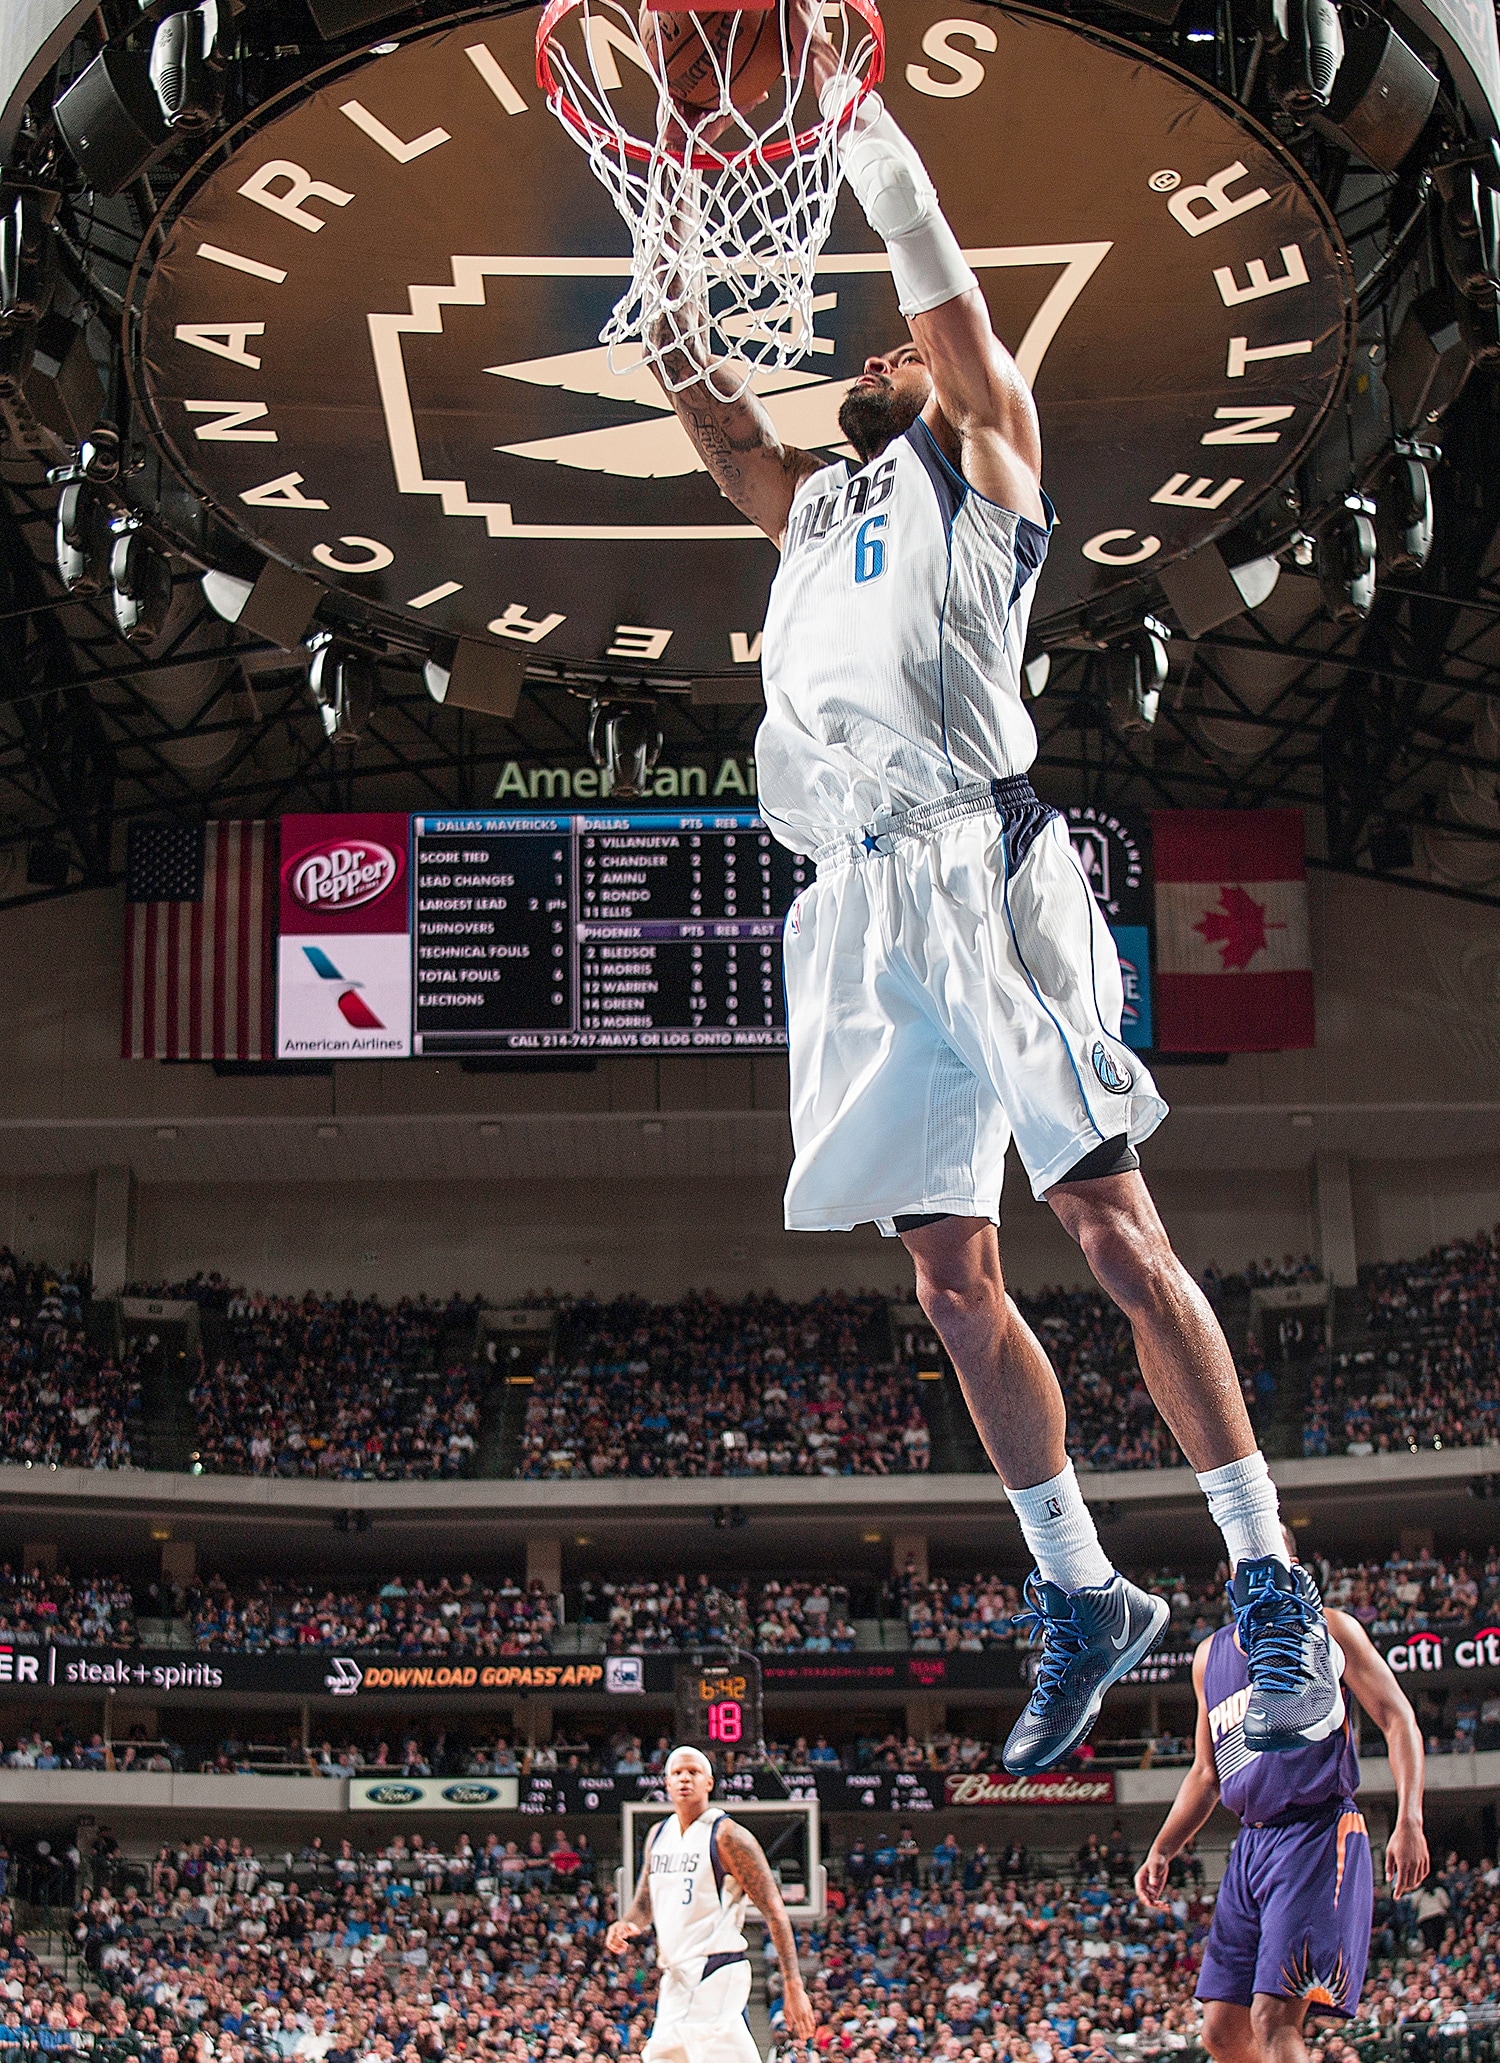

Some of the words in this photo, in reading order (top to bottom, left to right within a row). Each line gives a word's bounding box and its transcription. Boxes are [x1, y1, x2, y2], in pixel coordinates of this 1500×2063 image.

[855, 513, 889, 586] 6
[436, 821, 483, 832] DALLAS
[486, 820, 557, 832] MAVERICKS
[584, 819, 630, 830] DALLAS
[680, 818, 703, 830] PTS
[715, 818, 738, 830] REB
[584, 837, 595, 848] 3
[601, 836, 680, 849] VILLANUEVA
[330, 848, 366, 879] Dr
[419, 852, 460, 863] SCORE
[463, 852, 489, 863] TIED
[584, 855, 596, 868] 6
[600, 855, 668, 867] CHANDLER
[293, 855, 389, 905] Pepper
[419, 876, 451, 887] LEAD
[455, 875, 515, 887] CHANGES
[584, 872, 595, 884] 7
[601, 872, 647, 884] AMINU
[584, 889, 596, 902] 9
[601, 889, 651, 902] RONDO
[419, 899, 473, 911] LARGEST
[476, 899, 507, 911] LEAD
[529, 899, 539, 911] 2
[546, 899, 567, 913] pts
[584, 906, 600, 917] 11
[602, 906, 632, 918] ELLIS
[419, 923, 495, 934] TURNOVERS
[584, 927, 642, 938] PHOENIX
[680, 925, 704, 938] PTS
[715, 925, 740, 937] REB
[751, 925, 776, 937] AST
[419, 946, 486, 959] TECHNICAL
[488, 946, 530, 958] FOULS
[585, 947, 596, 960] 2
[601, 946, 657, 959] BLEDSOE
[419, 970, 458, 982] TOTAL
[461, 970, 501, 982] FOULS
[584, 964, 600, 976] 11
[602, 963, 653, 975] MORRIS
[584, 981, 600, 994] 12
[602, 981, 659, 993] WARREN
[419, 994, 485, 1006] EJECTIONS
[603, 998, 645, 1011] GREEN
[584, 1016, 600, 1028] 15
[603, 1016, 653, 1028] MORRIS
[285, 1038, 352, 1051] American
[353, 1037, 403, 1050] Airlines
[508, 1036, 540, 1048] CALL
[542, 1034, 638, 1047] 214-747-MAVS
[641, 1034, 660, 1046] OR
[663, 1034, 690, 1046] LOG
[693, 1033, 732, 1045] ONTO
[65, 1657, 223, 1691] steak+spirits
[363, 1667, 478, 1688] DOWNLOAD
[559, 1664, 603, 1687] APP
[699, 1676, 747, 1701] 6:42
[708, 1701, 743, 1743] 18
[945, 1773, 1110, 1805] Budweiser
[648, 1853, 701, 1875] DALLAS
[682, 1878, 694, 1905] 3
